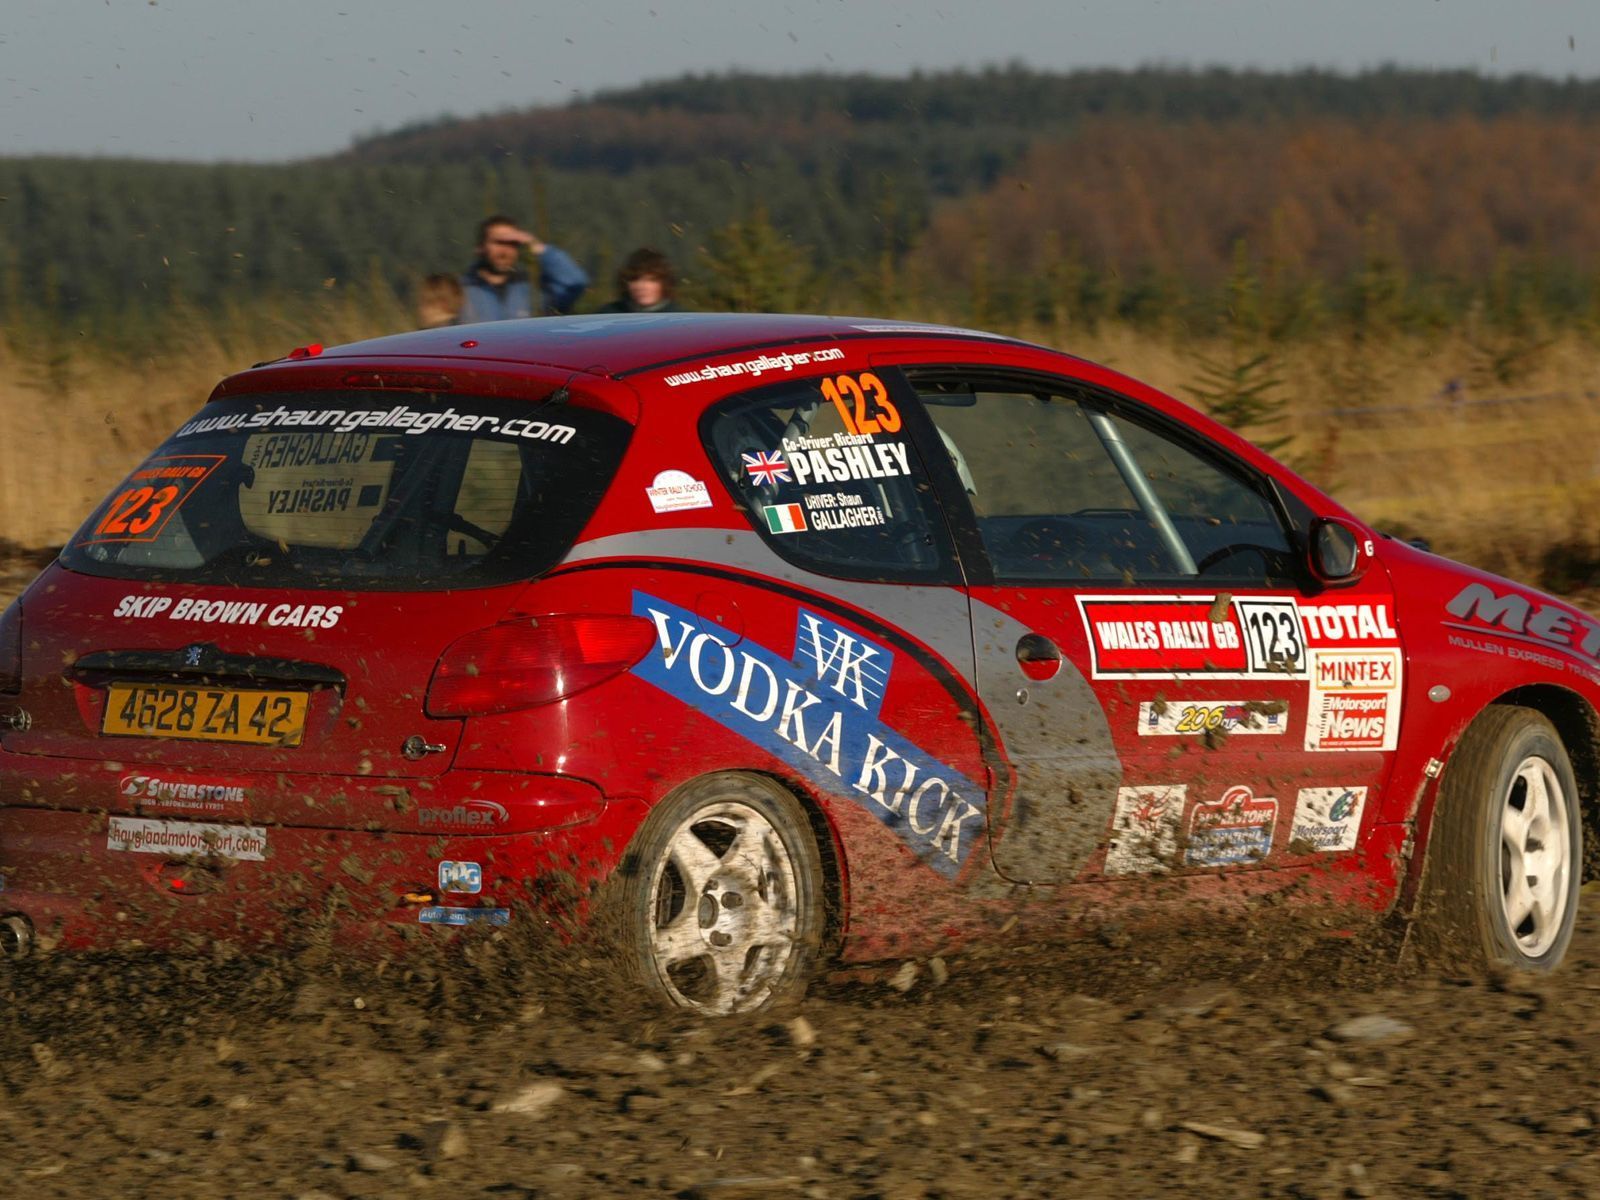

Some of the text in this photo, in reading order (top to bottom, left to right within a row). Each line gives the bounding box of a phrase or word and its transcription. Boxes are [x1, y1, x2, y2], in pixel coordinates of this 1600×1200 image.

[664, 348, 845, 387] www.shaungallagher.com
[820, 372, 902, 435] 123
[176, 405, 577, 445] www.shaungallagher.com
[782, 435, 835, 451] Co-Driver:
[788, 441, 911, 485] PASHLEY
[94, 485, 179, 535] 123
[805, 492, 864, 510] DRIVER: Shaun
[811, 506, 878, 531] GALLAGHER
[113, 596, 343, 629] SKIP BROWN CARS
[1301, 604, 1397, 640] TOTAL
[1095, 621, 1240, 649] WALES RALLY GB
[1250, 611, 1301, 664] 123
[803, 613, 880, 711] VK
[1448, 635, 1505, 656] MULLEN
[1508, 647, 1565, 671] EXPRESS
[1321, 661, 1392, 681] MINTEX
[119, 688, 293, 738] 4628 ZA 42
[1175, 705, 1225, 732] 206
[1329, 696, 1387, 713] Motorsport
[647, 607, 982, 863] VODKA KICK
[1324, 710, 1385, 739] News
[147, 779, 244, 802] SILVERSTONE
[418, 806, 496, 826] proflex
[1296, 824, 1348, 837] Motorsport
[112, 823, 262, 853] hauglandmotorort.com
[1306, 834, 1343, 847] reland
